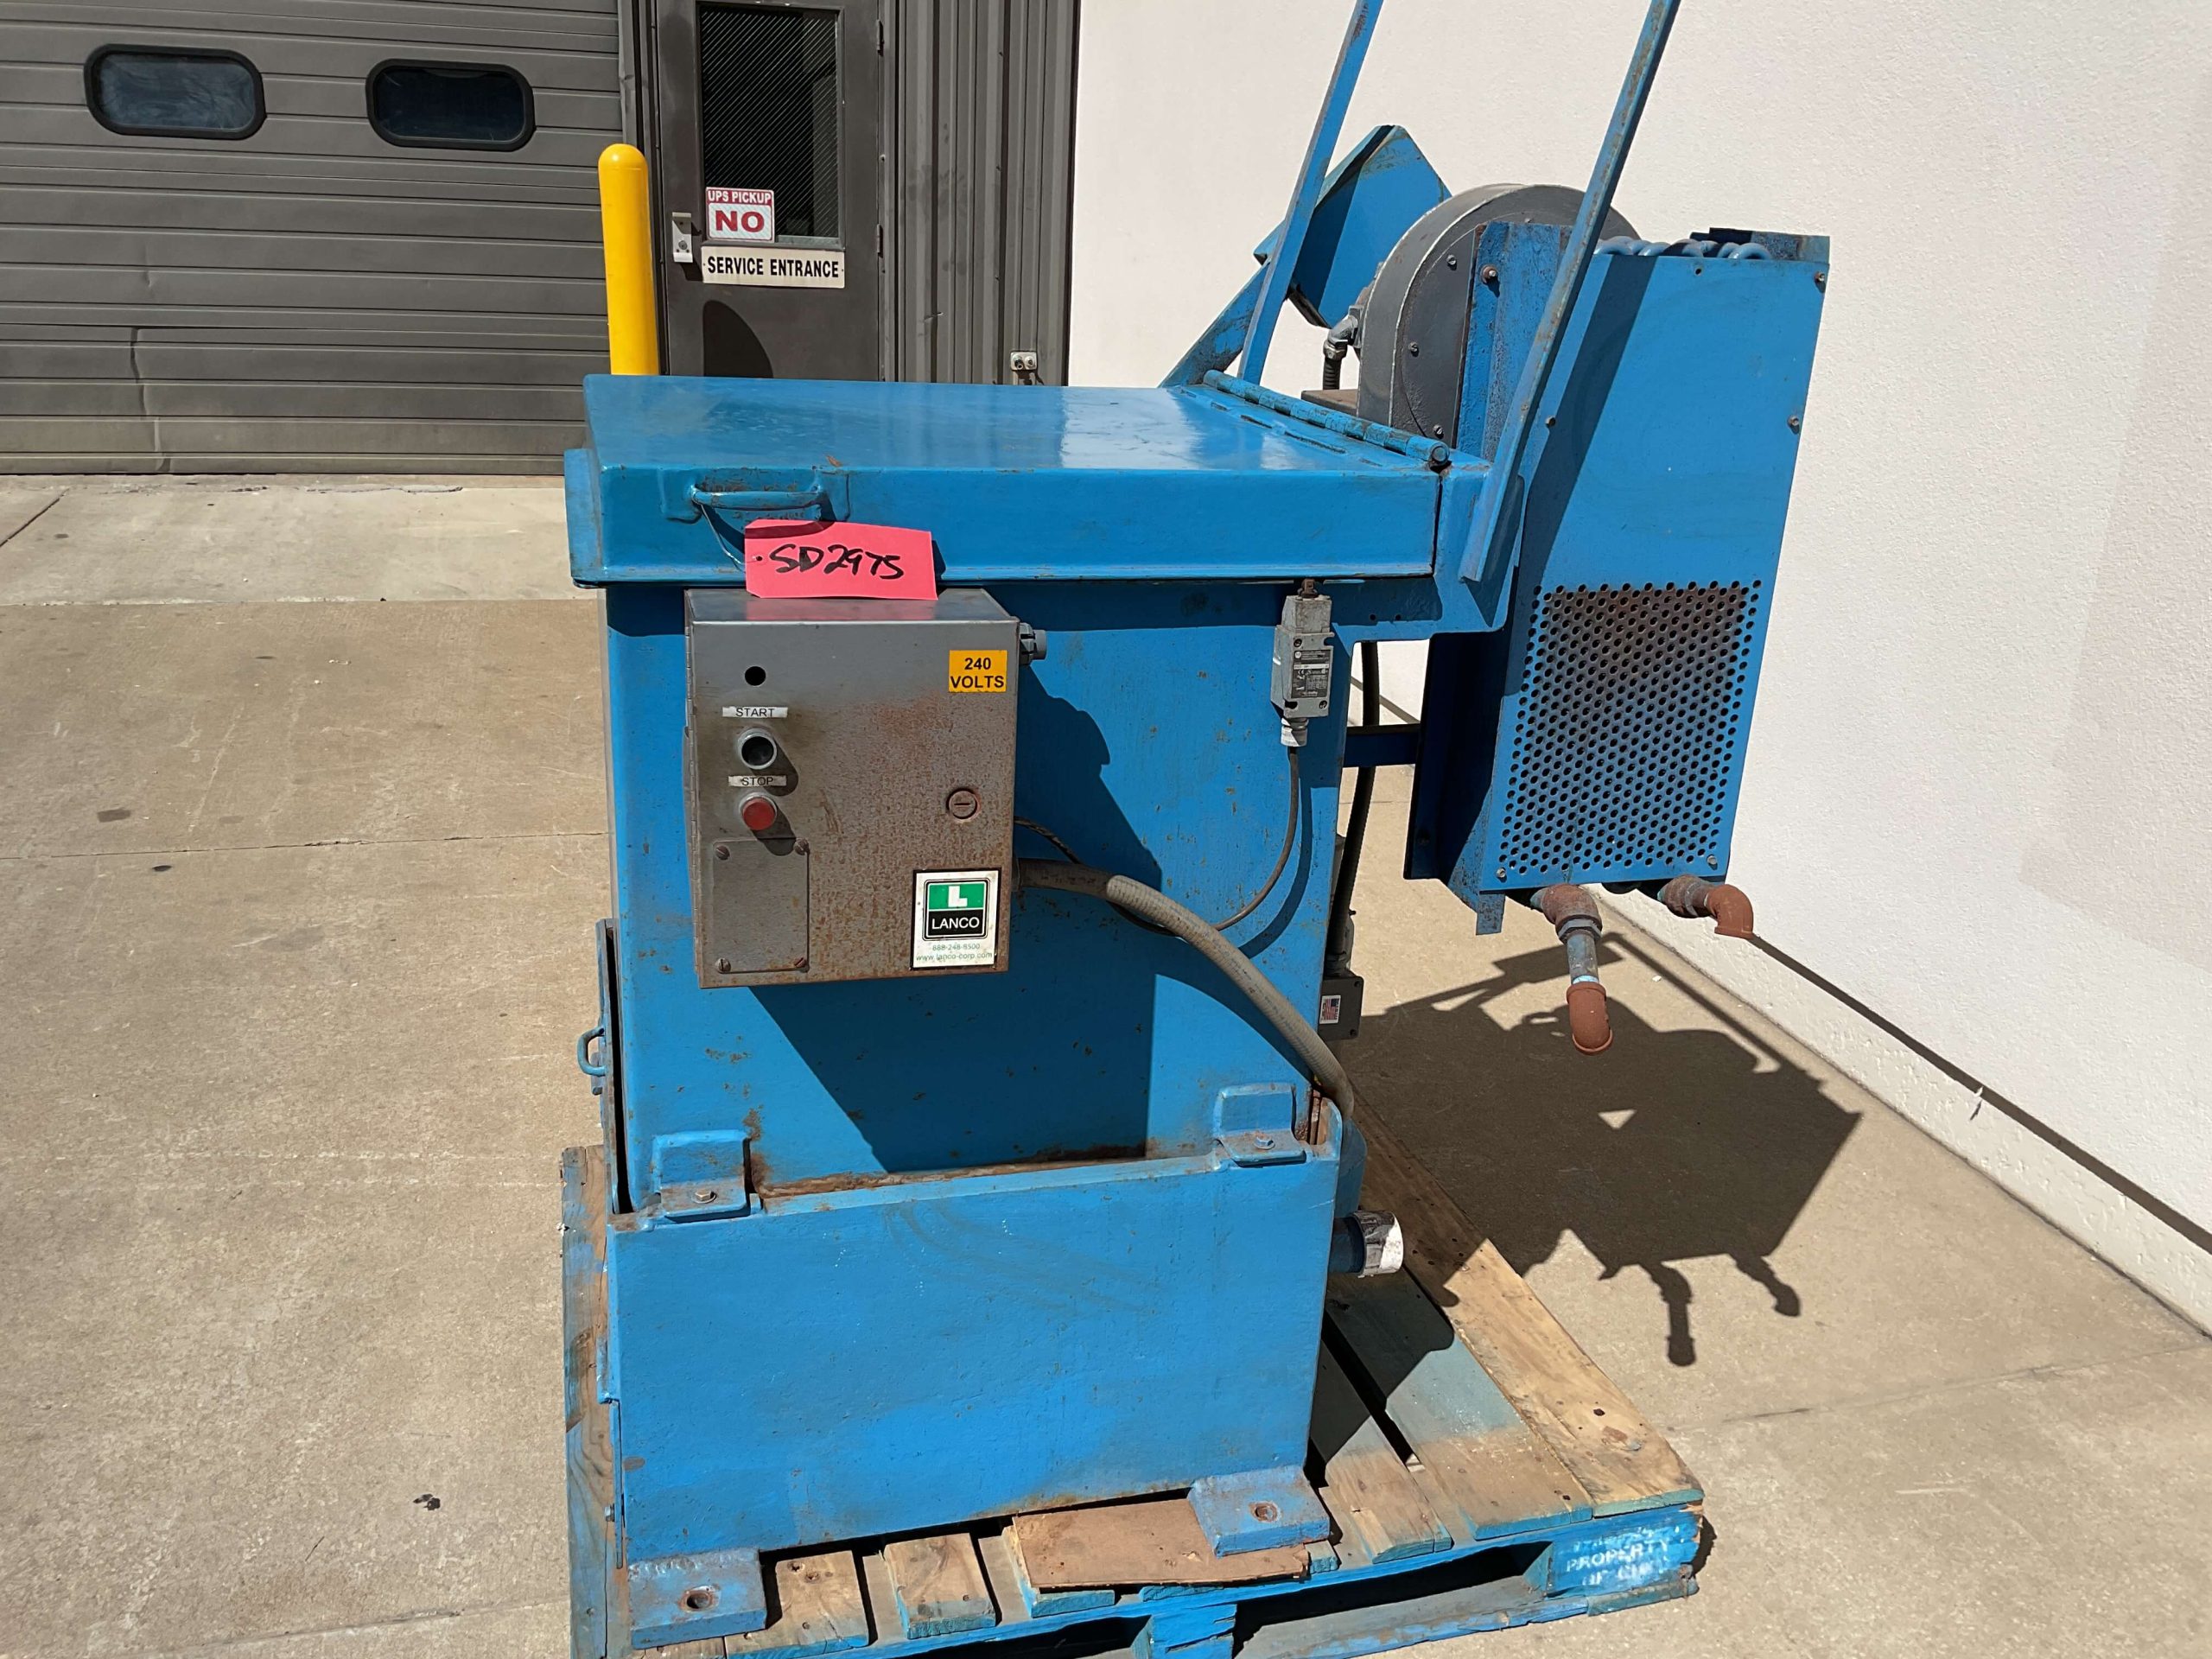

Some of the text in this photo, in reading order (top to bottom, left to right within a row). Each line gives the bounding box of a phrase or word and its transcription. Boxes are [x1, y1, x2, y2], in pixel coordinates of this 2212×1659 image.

[708, 190, 772, 204] UPS PICKUP
[715, 210, 765, 232] NO
[708, 256, 839, 278] SERVICE ENTRANCE
[769, 543, 904, 579] SD2975
[964, 658, 991, 670] 240
[950, 676, 1004, 689] VOLTS
[735, 708, 775, 717] START
[741, 777, 774, 786] STOP
[931, 917, 980, 930] LANCO
